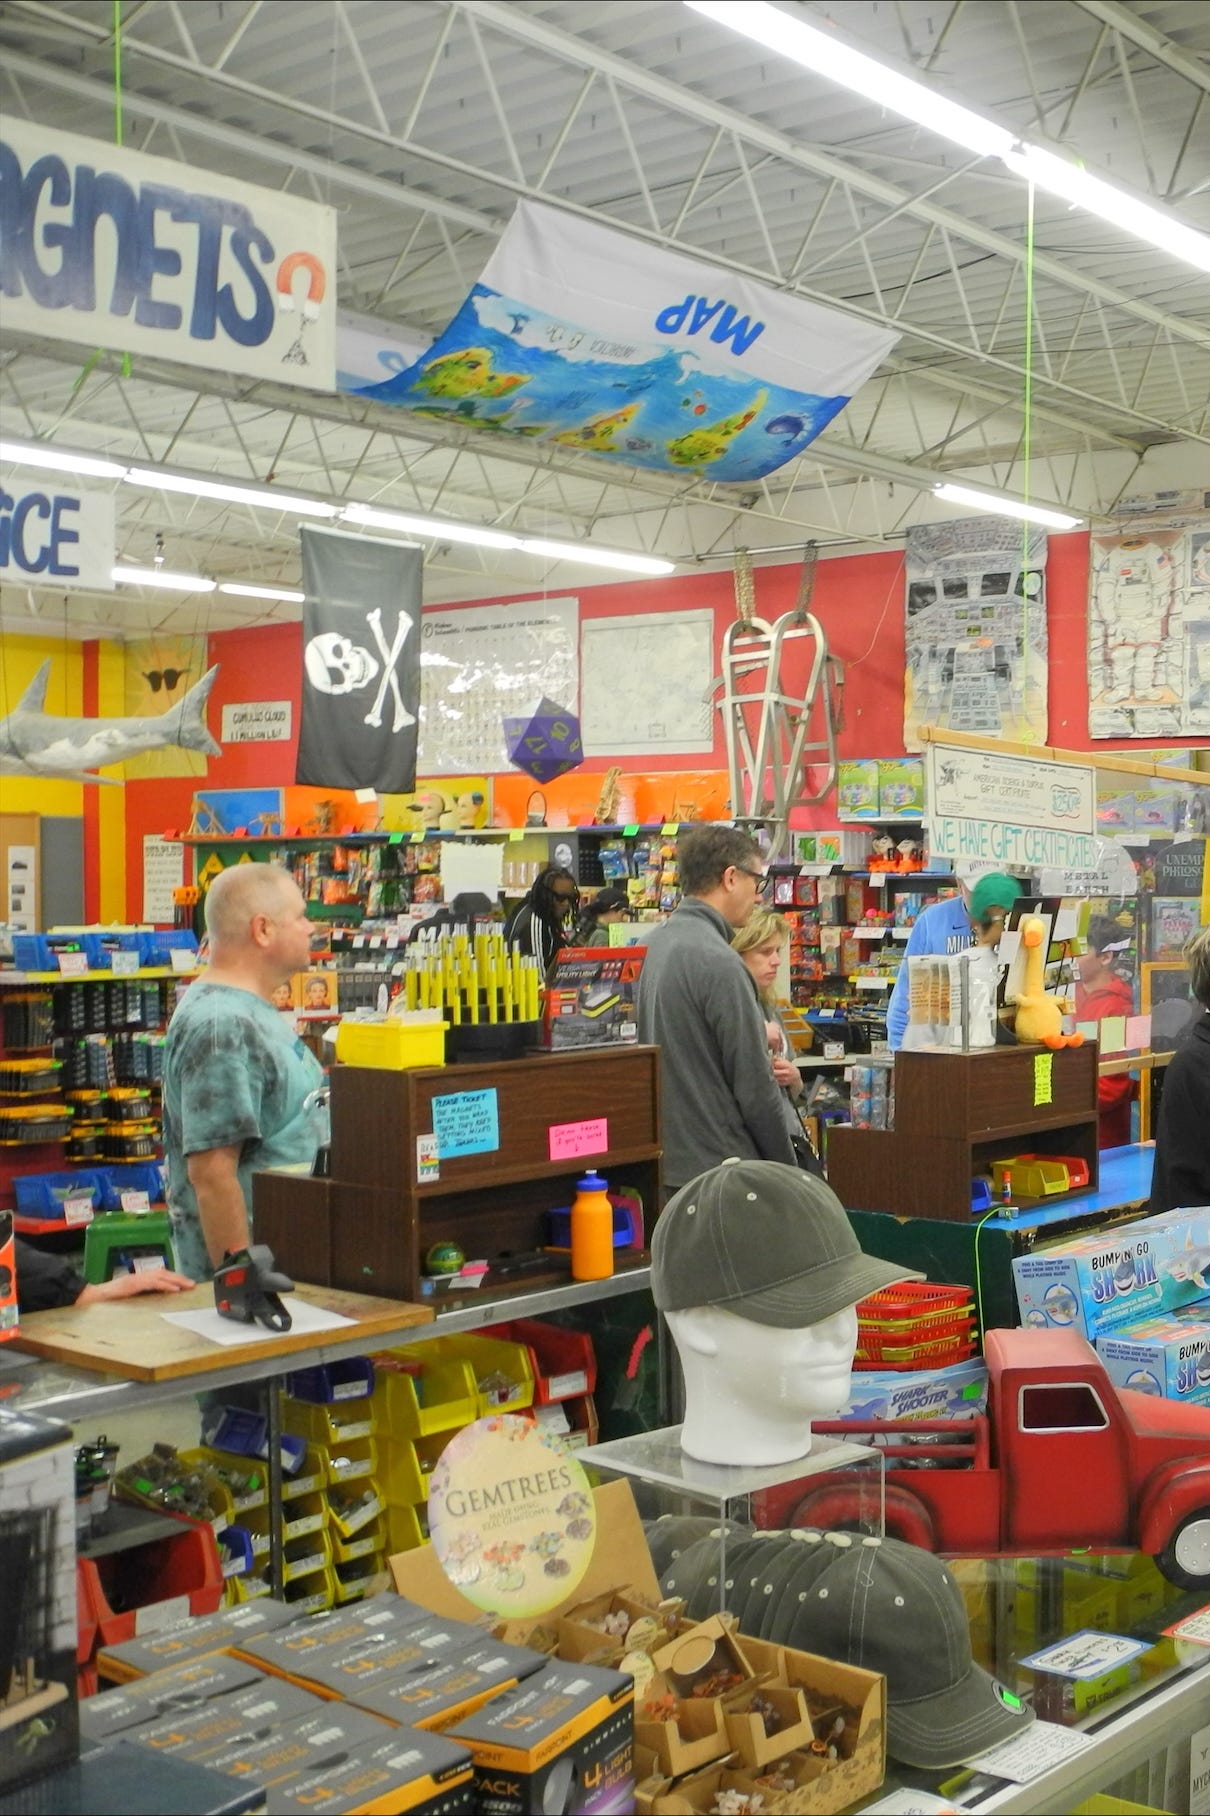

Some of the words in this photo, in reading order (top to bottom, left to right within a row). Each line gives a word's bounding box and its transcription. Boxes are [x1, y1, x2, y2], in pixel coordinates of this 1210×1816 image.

[655, 295, 766, 356] MAP
[932, 820, 955, 853] WE
[958, 821, 988, 857] HAVE
[990, 823, 1022, 861] GIFT
[1024, 829, 1098, 868] CERTIFICATES
[1063, 871, 1109, 881] METAL
[1065, 885, 1109, 894] EARTH
[1091, 1252, 1122, 1271] BUMP
[1136, 1240, 1149, 1257] GO
[1179, 1342, 1206, 1361] BUMP
[891, 1384, 931, 1407] SHARK
[896, 1389, 949, 1417] SHOOTER
[400, 1687, 434, 1702] 4
[502, 1715, 535, 1730] 4
[584, 1762, 602, 1789] 4
[603, 1744, 633, 1776] LIGHT
[604, 1759, 633, 1790] BULB
[296, 1785, 335, 1804] 4
[584, 1789, 602, 1808] PACK
